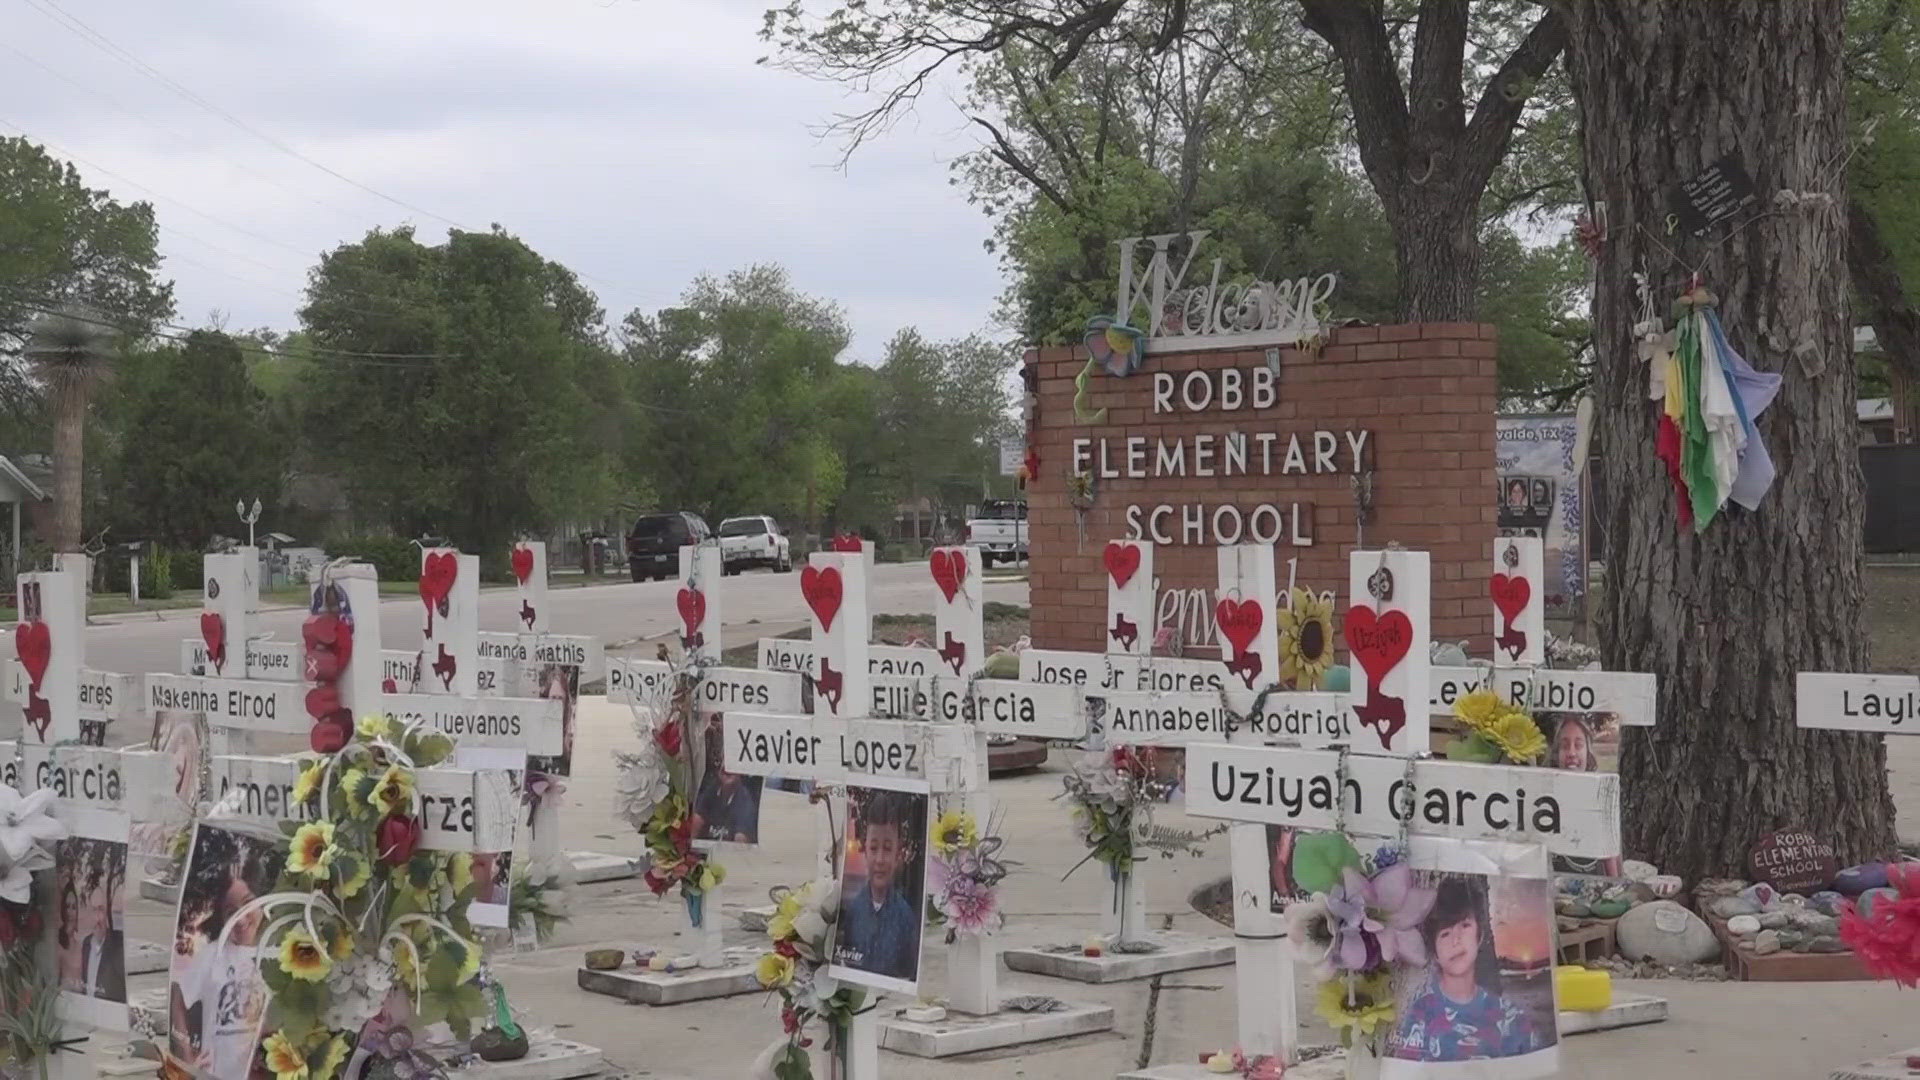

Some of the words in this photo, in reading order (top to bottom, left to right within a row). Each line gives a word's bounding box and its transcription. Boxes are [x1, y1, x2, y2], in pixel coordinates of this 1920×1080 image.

[1154, 366, 1276, 414] ROBB
[1496, 427, 1540, 441] valde,
[1542, 427, 1560, 440] TX
[1073, 429, 1368, 478] ELEMENTARY
[1125, 502, 1312, 546] SCHOOL
[246, 652, 289, 670] driguez
[535, 643, 585, 663] Mathis
[868, 658, 924, 676] ravo
[384, 660, 421, 681] lithia
[1031, 660, 1087, 686] Jose
[1101, 663, 1124, 689] Jr
[1138, 668, 1224, 692] Flores
[79, 682, 113, 706] ares
[152, 685, 219, 713] Makenna
[228, 690, 277, 720] Elrod
[705, 680, 769, 705] orres
[873, 686, 928, 716] Ellie
[942, 691, 1036, 723] Garcia
[1511, 680, 1595, 710] Rubio
[1843, 690, 1920, 725] Layl
[738, 728, 822, 767] Xavier
[840, 734, 919, 774] Lopez
[37, 760, 121, 801] Garcia
[422, 793, 474, 833] rza
[1211, 761, 1362, 819] Uziyah
[1388, 778, 1561, 834] Garcia
[1769, 860, 1823, 878] SCHOOL
